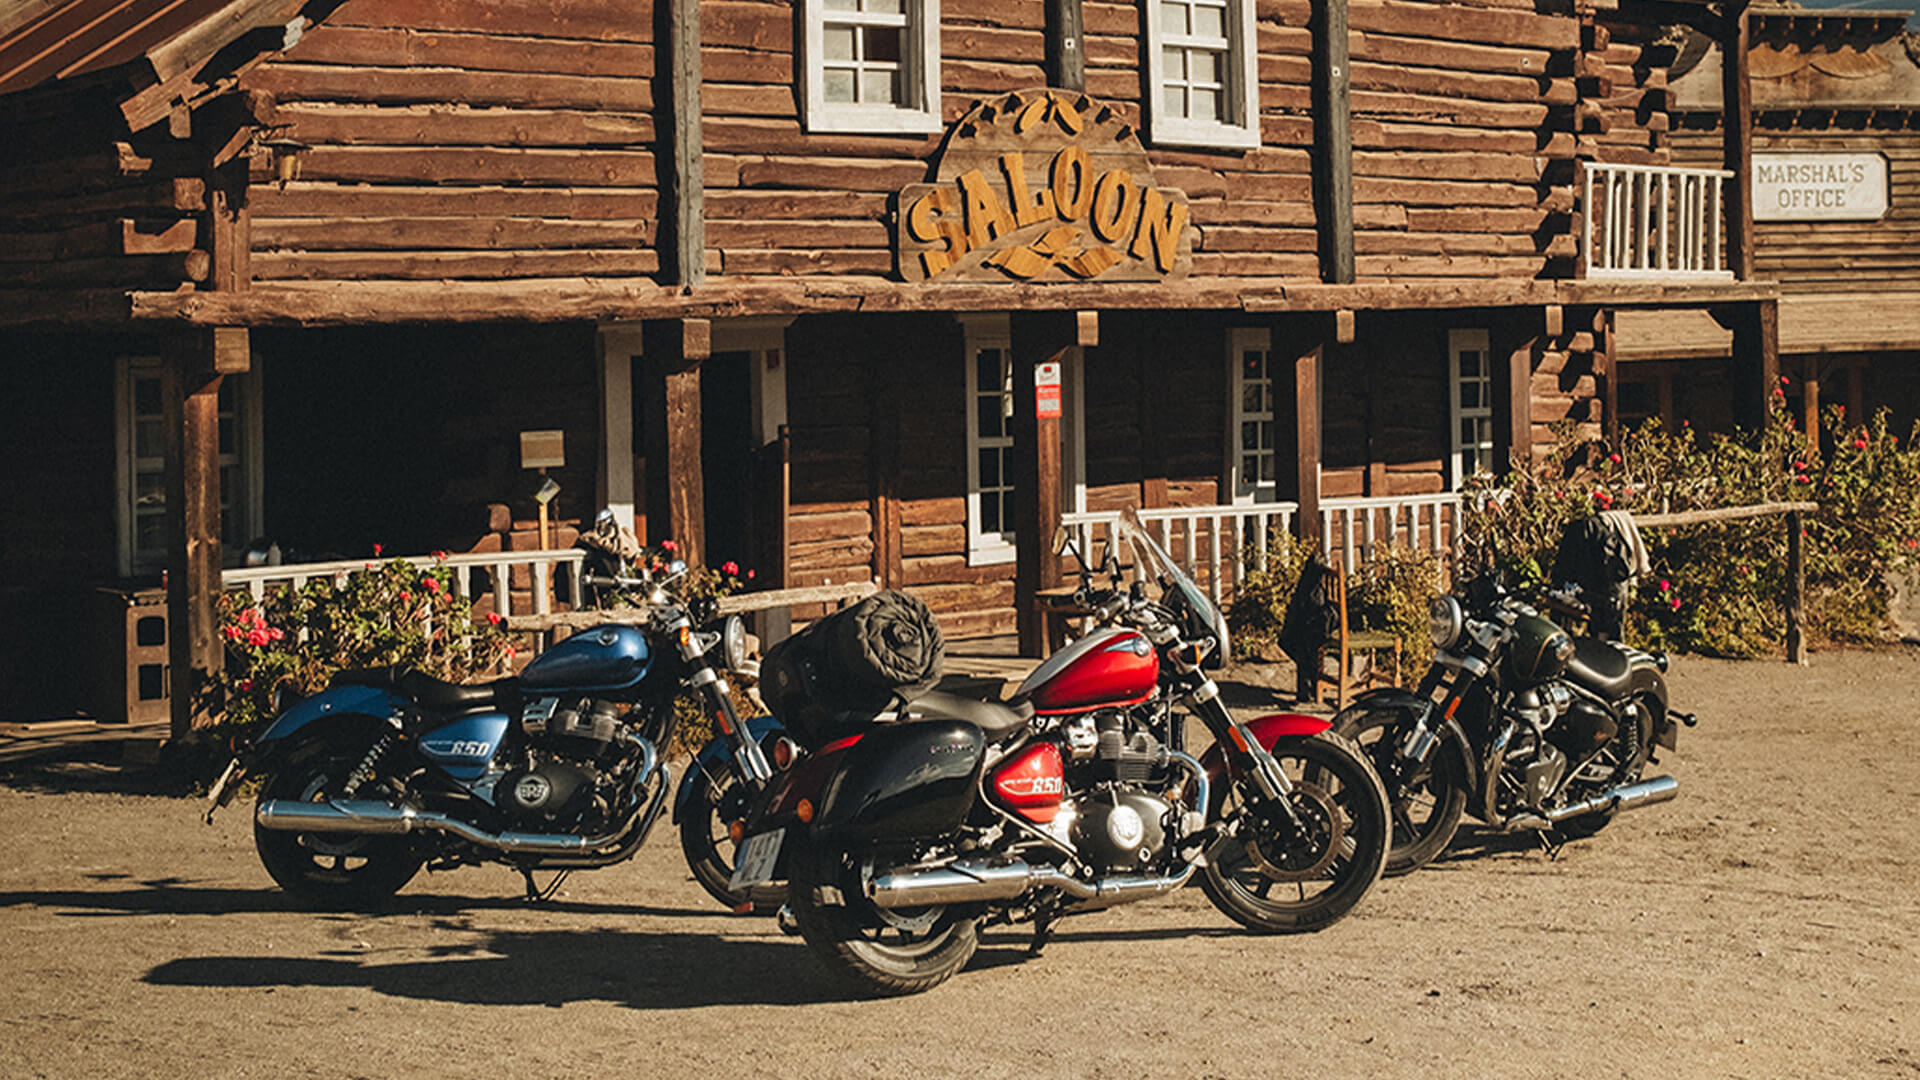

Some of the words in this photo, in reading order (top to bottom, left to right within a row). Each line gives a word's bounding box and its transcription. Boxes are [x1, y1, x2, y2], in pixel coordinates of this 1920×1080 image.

[1758, 163, 1865, 184] MARSHAL'S
[1778, 189, 1845, 208] OFFICE
[907, 145, 1188, 279] SALOON
